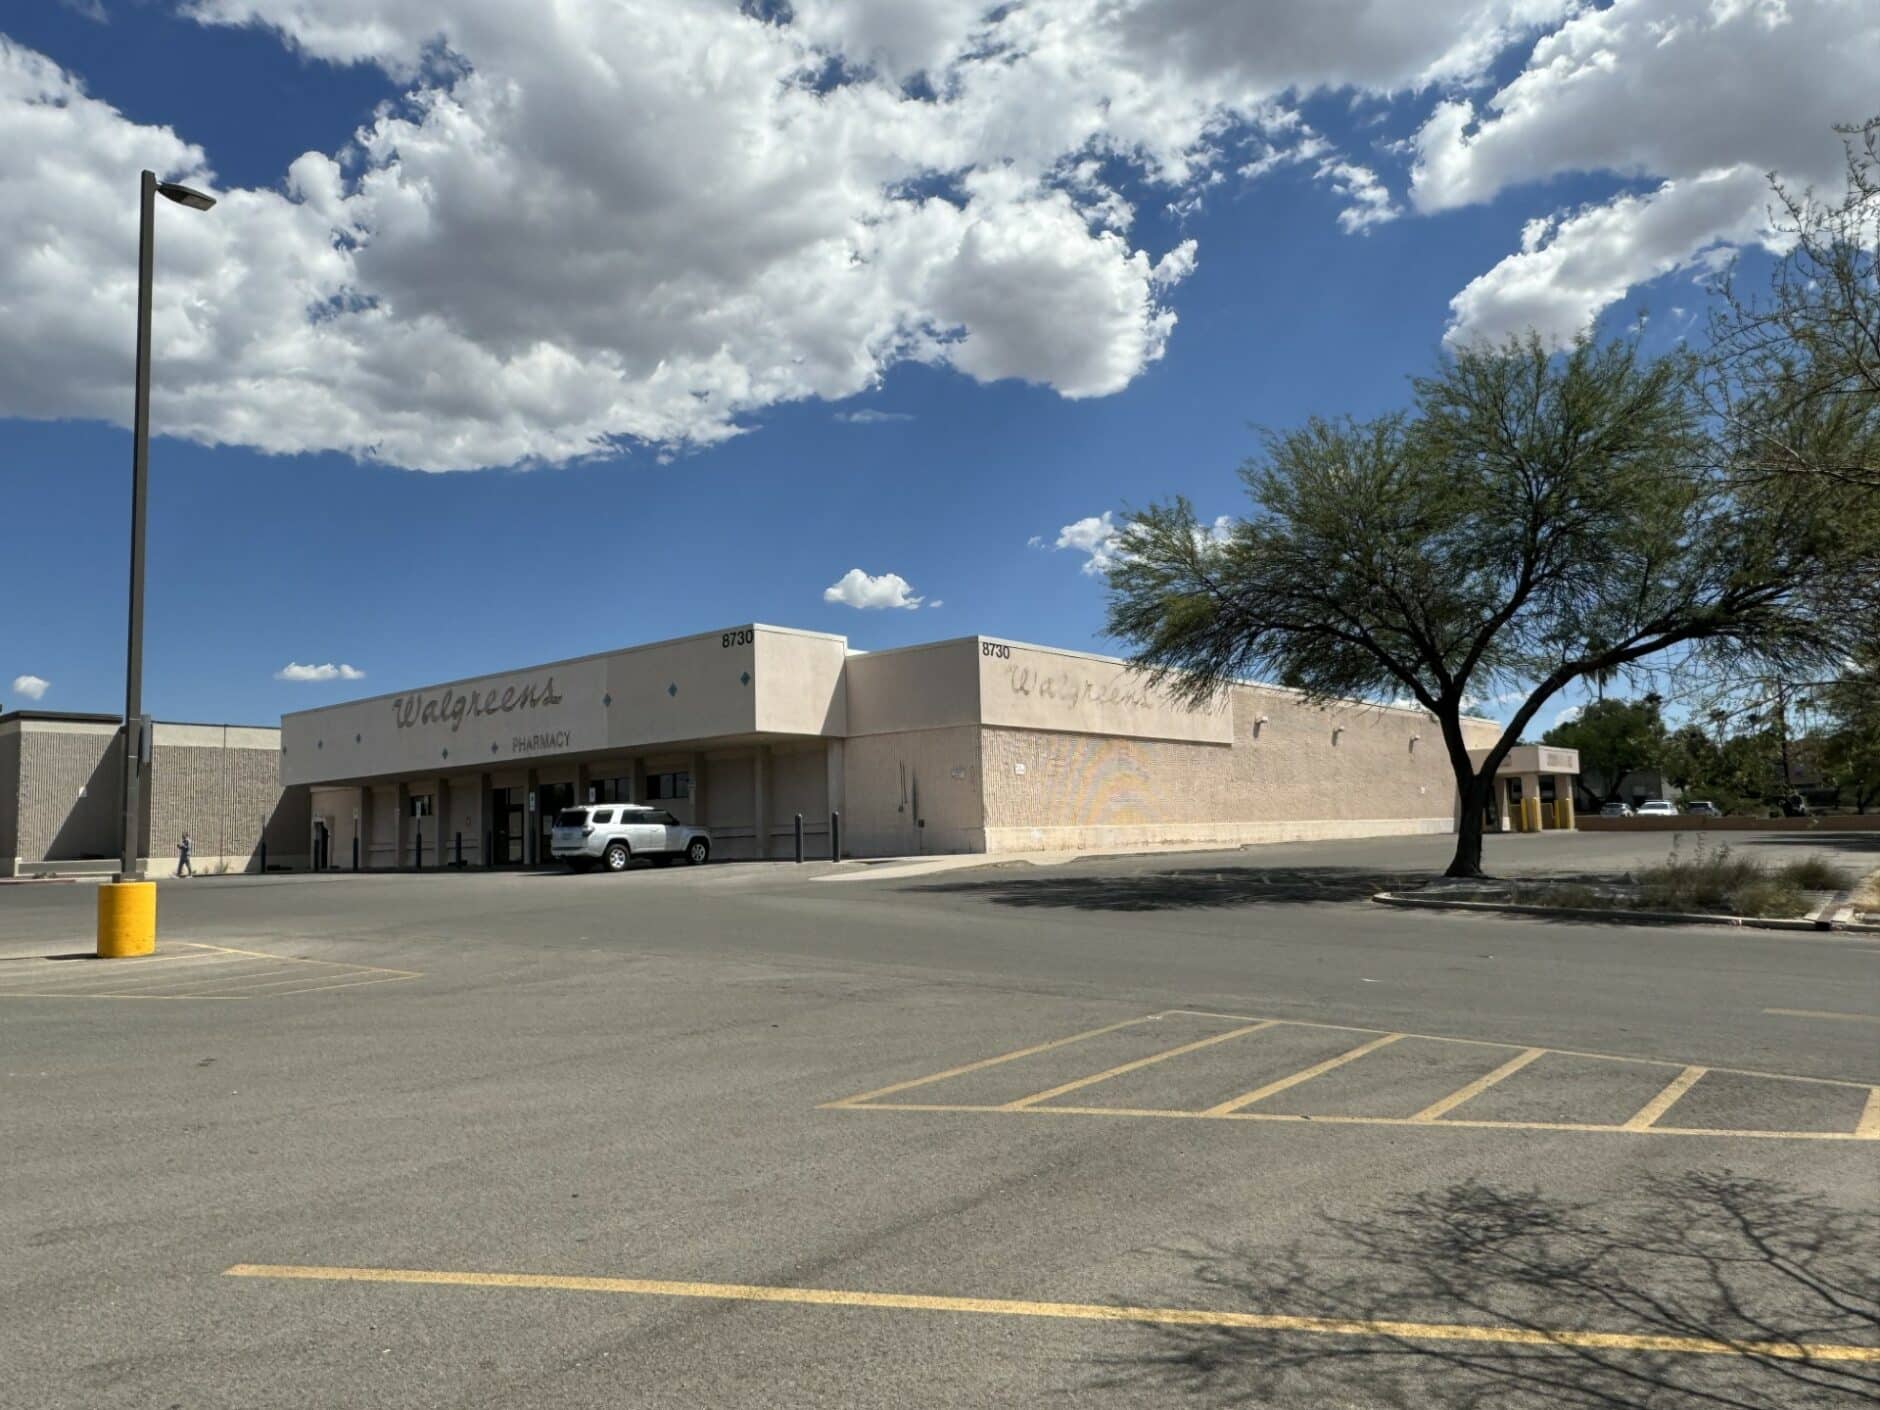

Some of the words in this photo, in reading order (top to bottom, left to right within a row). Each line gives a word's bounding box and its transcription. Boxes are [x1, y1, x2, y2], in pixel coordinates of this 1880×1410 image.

[722, 630, 754, 648] 8730
[982, 641, 1010, 659] 8730
[392, 677, 562, 732] Walgreens
[512, 731, 571, 752] PHARMACY
